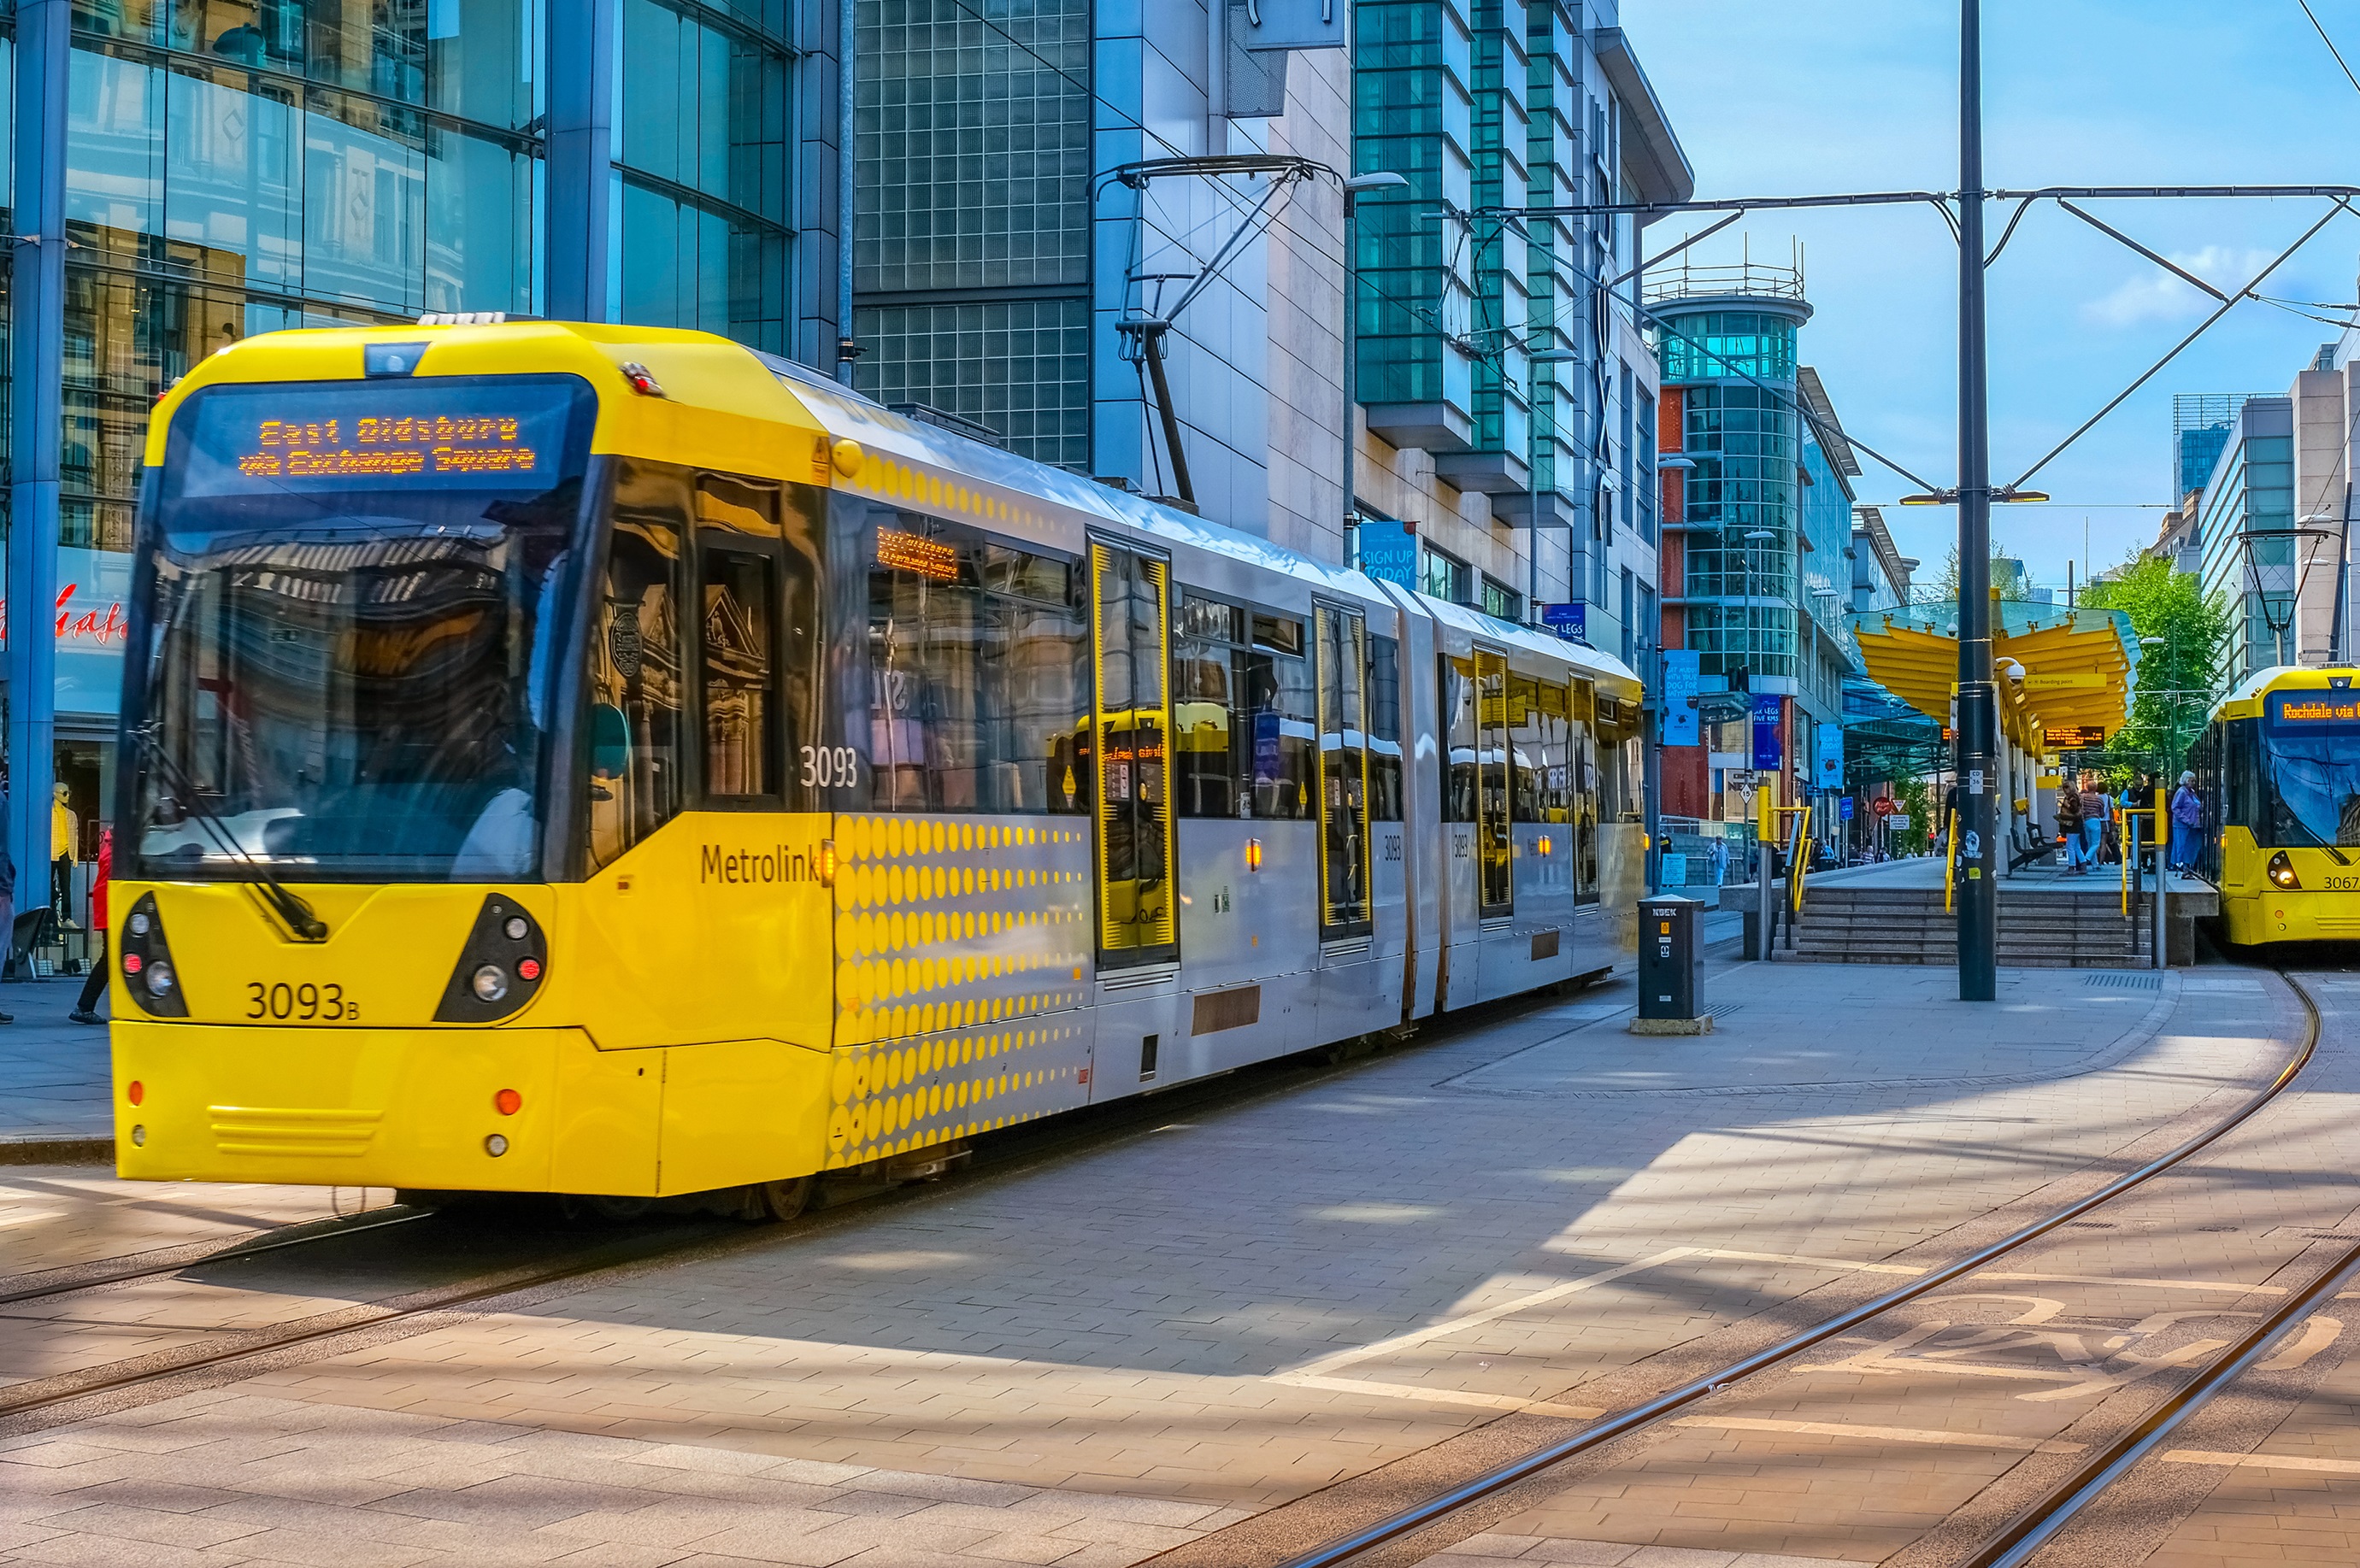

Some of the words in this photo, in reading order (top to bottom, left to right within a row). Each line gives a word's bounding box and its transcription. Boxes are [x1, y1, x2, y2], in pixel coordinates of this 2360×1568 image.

[259, 418, 339, 445] East
[357, 415, 518, 443] Didsbury
[286, 449, 425, 475] Exchange
[432, 446, 536, 472] Square
[1364, 550, 1392, 565] SIGN
[1397, 550, 1413, 564] UP
[1364, 565, 1413, 583] TODAY
[1561, 623, 1583, 634] LEGS
[1667, 681, 1683, 690] DOG
[1685, 681, 1698, 690] FOR
[2283, 702, 2333, 719] Rochdale
[2335, 703, 2354, 718] via
[800, 745, 857, 788] 3093
[1384, 835, 1401, 861] 3093
[1454, 834, 1468, 858] 3093
[701, 844, 820, 884] Metrolink
[2323, 876, 2360, 890] 3067
